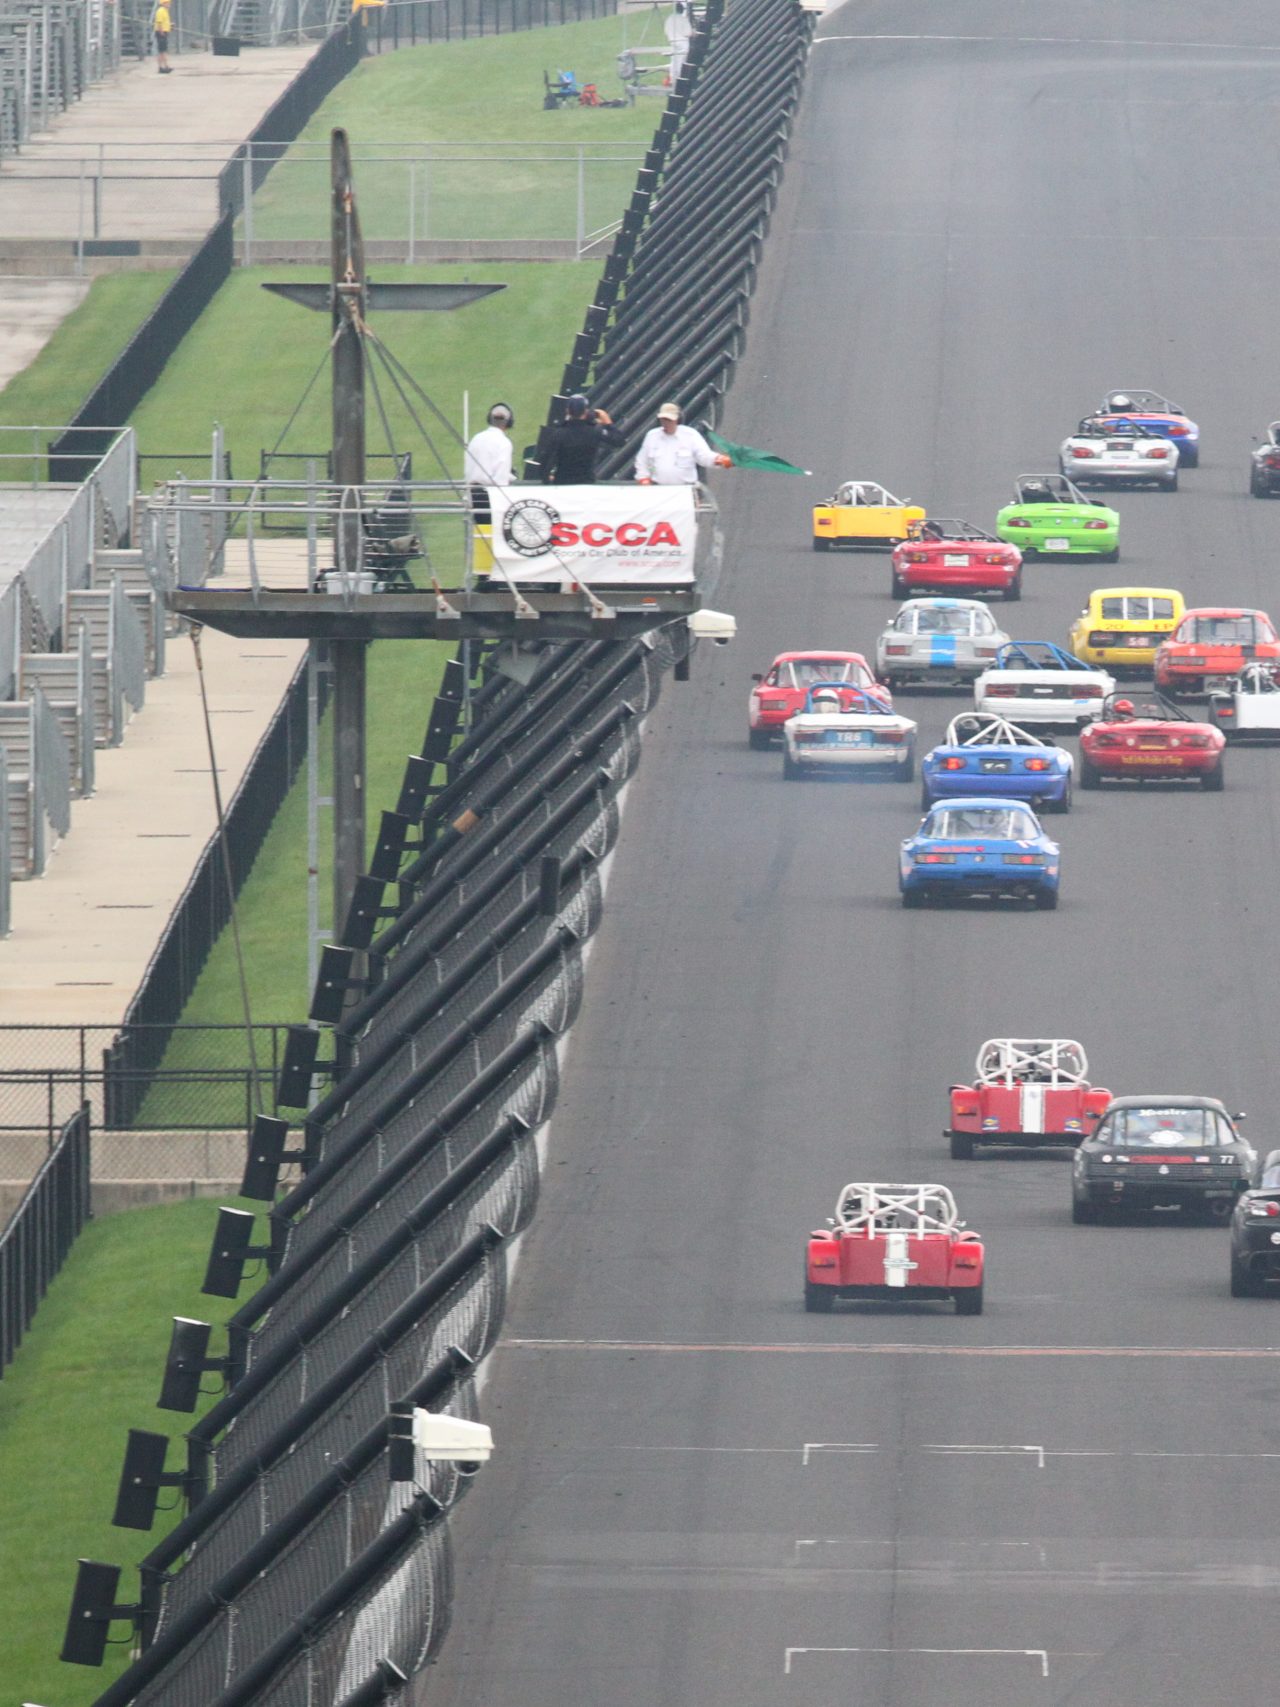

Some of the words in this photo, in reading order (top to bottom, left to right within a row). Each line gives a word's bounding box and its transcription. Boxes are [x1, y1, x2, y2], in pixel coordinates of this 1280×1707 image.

[551, 521, 681, 547] SCCA
[553, 549, 586, 558] Sports
[588, 548, 604, 557] Car
[606, 547, 629, 557] Club
[631, 548, 642, 556] of
[1220, 1155, 1234, 1164] 77
